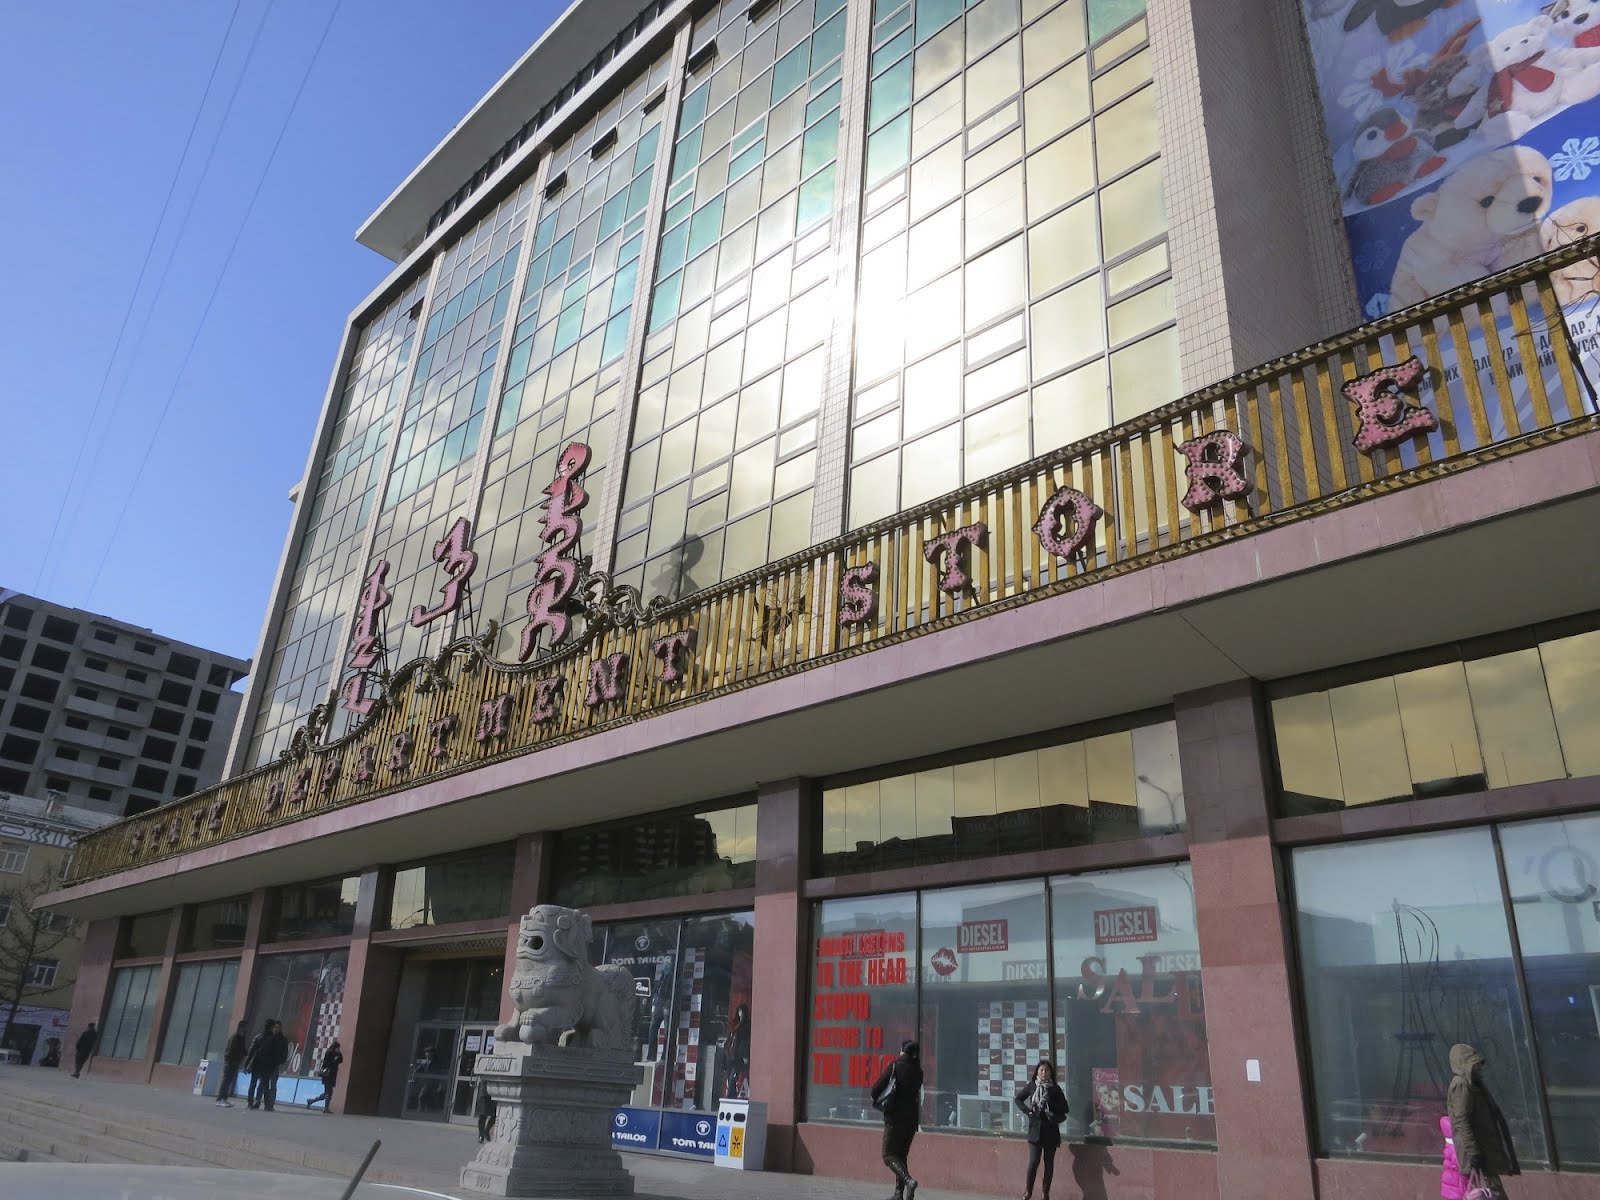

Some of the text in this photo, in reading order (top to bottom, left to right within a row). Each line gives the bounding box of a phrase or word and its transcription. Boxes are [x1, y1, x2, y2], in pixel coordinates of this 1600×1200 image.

[264, 628, 697, 815] DEPARTMENT
[837, 354, 1440, 630] STORE
[961, 923, 1005, 947] DIESEL
[1098, 911, 1153, 937] DIESEL
[611, 955, 672, 966] TOM TAILOR
[817, 961, 834, 988] TO
[838, 960, 863, 986] THE
[867, 957, 906, 985] HEAD
[814, 992, 870, 1021] STUPID
[865, 1026, 882, 1049] TO
[813, 1053, 842, 1085] THE
[1123, 1084, 1216, 1115] SALE
[617, 1131, 647, 1143] TAILOR
[672, 1137, 715, 1150] TOM TAI
